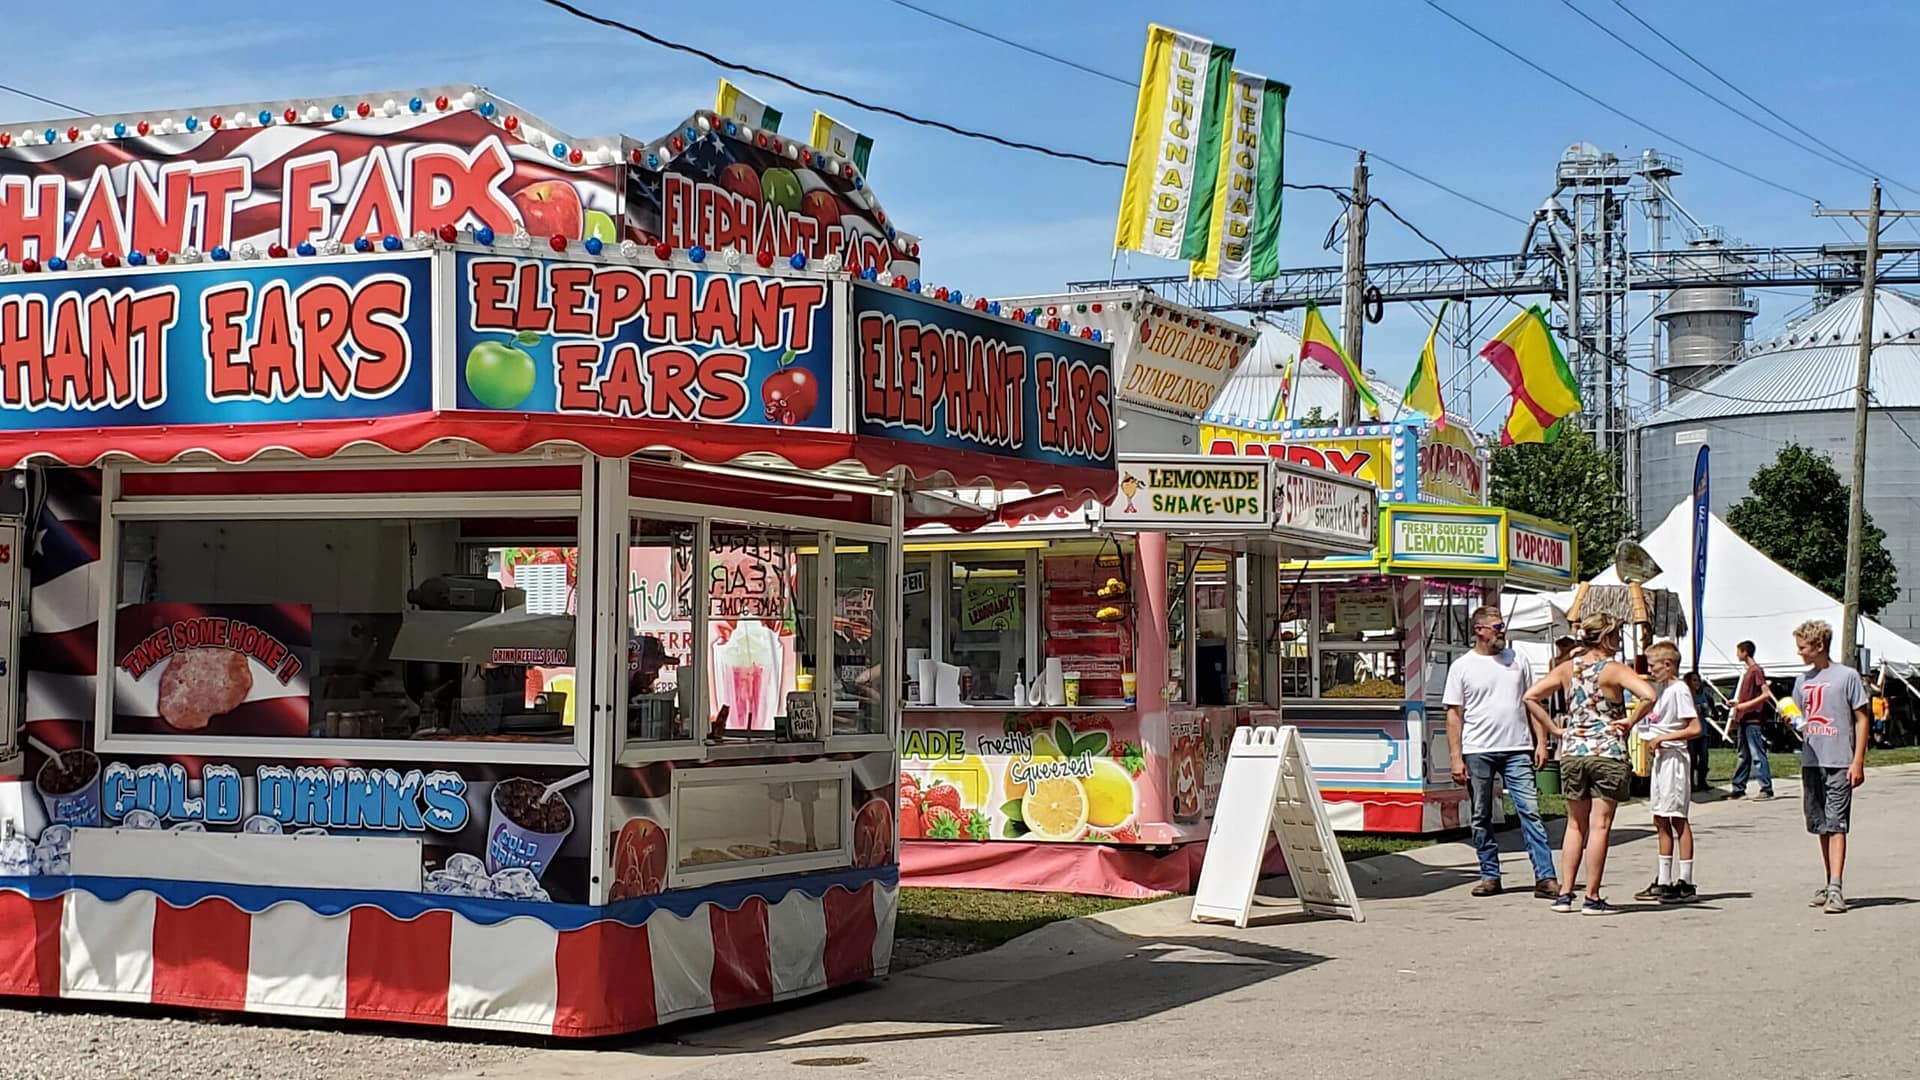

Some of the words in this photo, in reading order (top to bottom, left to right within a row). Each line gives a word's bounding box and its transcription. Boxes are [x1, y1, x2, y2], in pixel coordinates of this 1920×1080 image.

[1153, 52, 1196, 238] LEMONADE
[1226, 83, 1257, 262] LEMONADE
[663, 172, 819, 258] ELEPHANT
[466, 256, 828, 352] ELEPHANT
[201, 274, 412, 405] EARS
[1148, 324, 1188, 358] HOT
[1180, 334, 1231, 371] APPLE
[554, 340, 752, 421] EARS
[857, 309, 1028, 449] ELEPHANT
[1034, 351, 1111, 462] EARS
[1125, 363, 1215, 410] DUMPLINGS
[1148, 469, 1259, 490] LEMONADE
[1286, 475, 1337, 524] STRAWBERRY
[1152, 494, 1259, 516] SHAKE-UPS
[1314, 493, 1360, 535] SHORTCAKE
[1401, 522, 1434, 535] FRESH
[1436, 523, 1488, 536] SQUEEZED
[1405, 534, 1485, 554] LEMONADE
[1516, 531, 1562, 567] POPCORN
[122, 627, 174, 681] TAKE
[173, 617, 229, 650] SOME
[229, 619, 288, 673] HOME
[900, 729, 965, 760] ADE
[978, 732, 1033, 762] Freshly
[102, 761, 243, 824] COLD
[257, 764, 471, 833] DRINKS
[1011, 753, 1095, 795] Squeezed!
[498, 829, 538, 857] COLD
